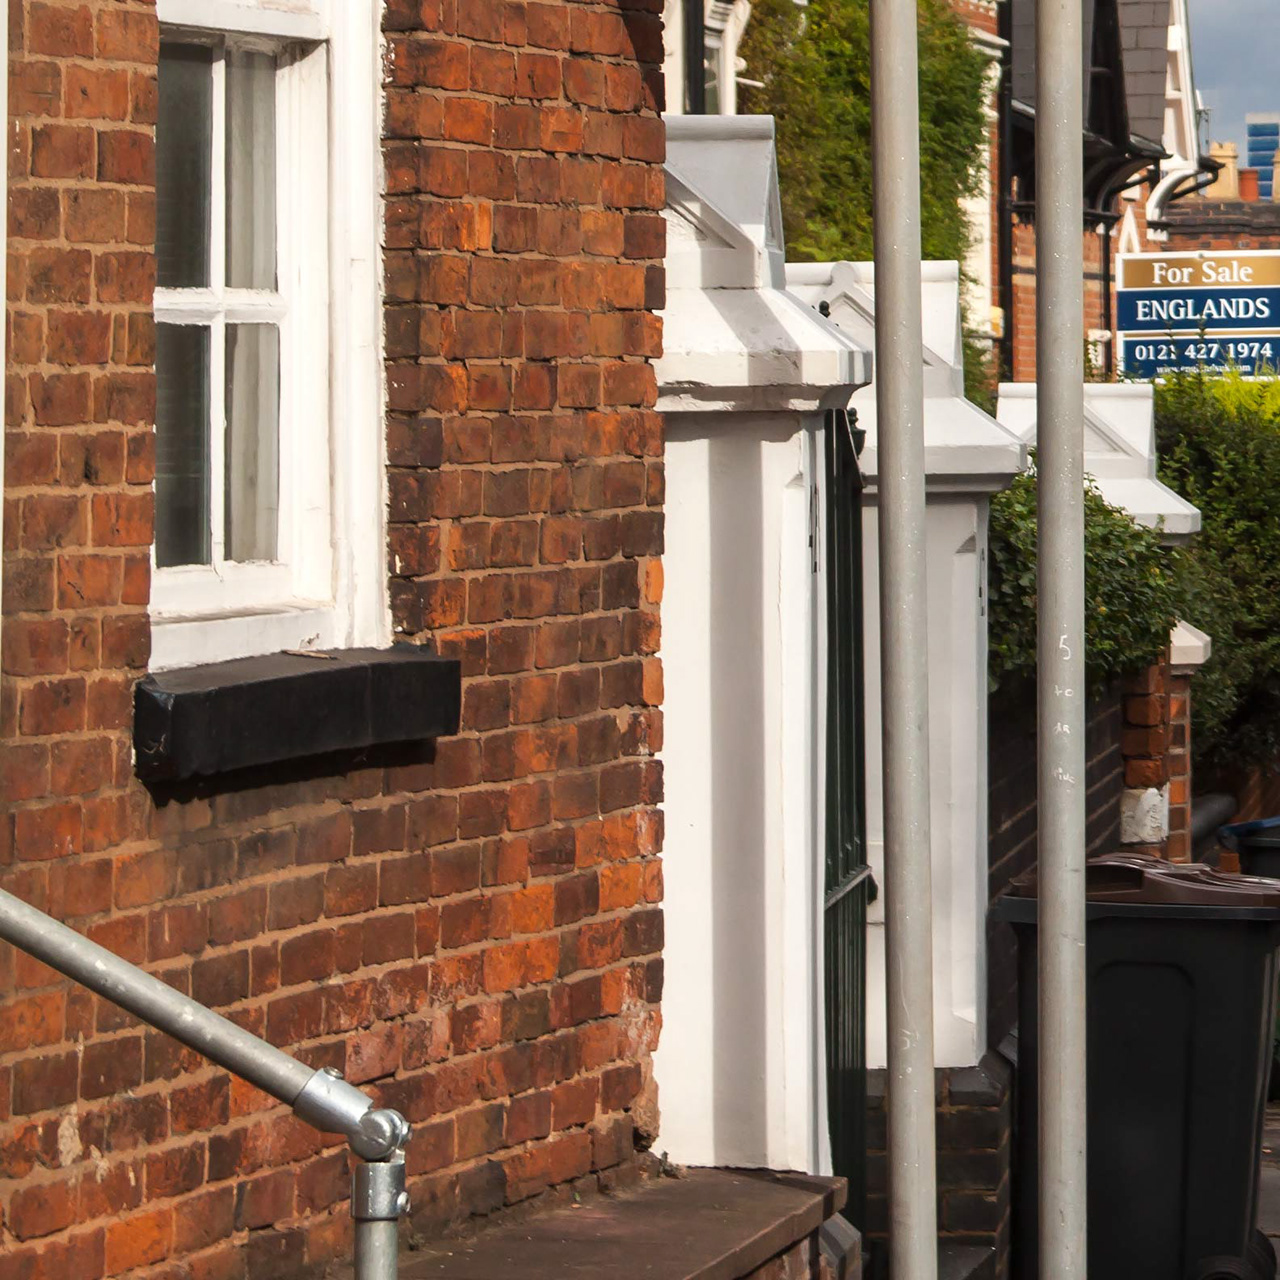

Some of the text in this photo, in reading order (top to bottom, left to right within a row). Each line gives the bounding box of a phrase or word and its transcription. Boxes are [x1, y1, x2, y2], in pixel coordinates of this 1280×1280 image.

[1152, 260, 1253, 284] For Sale
[1136, 297, 1270, 321] ENGLANDS
[1134, 342, 1273, 360] 0121 427 1974
